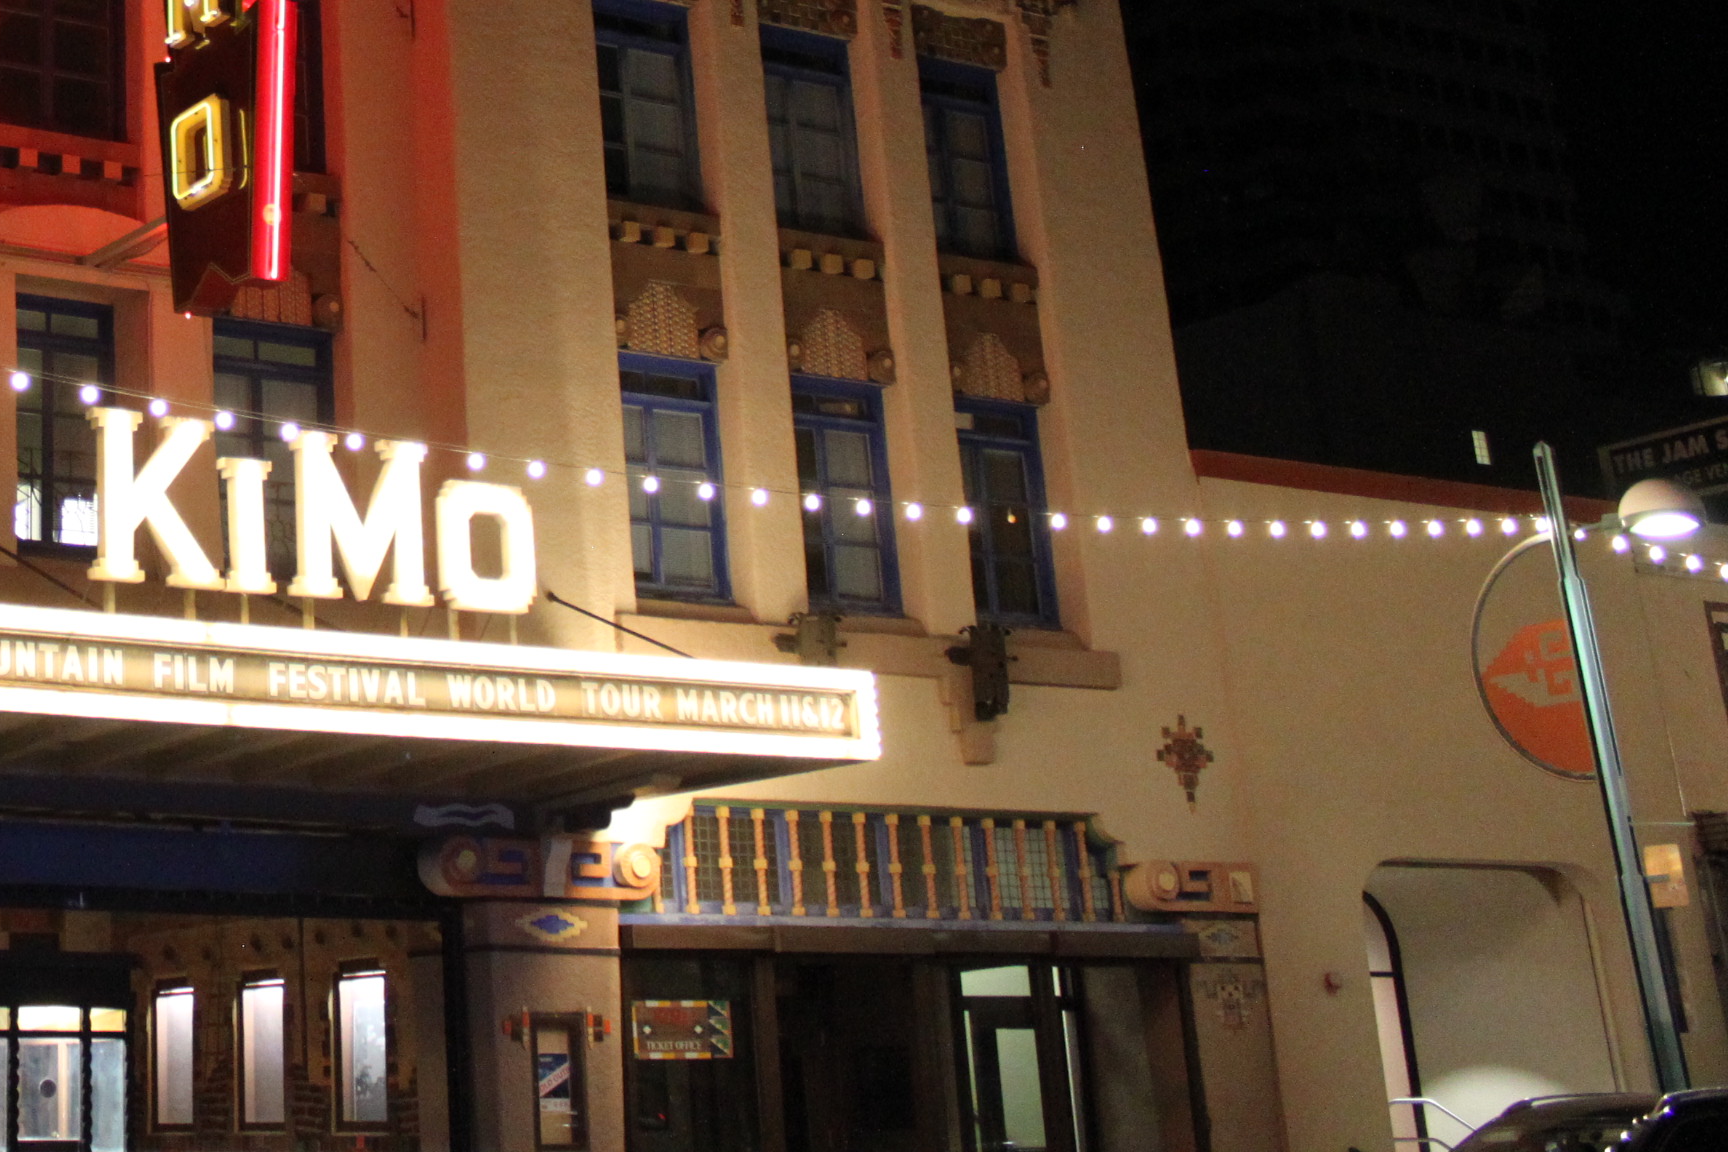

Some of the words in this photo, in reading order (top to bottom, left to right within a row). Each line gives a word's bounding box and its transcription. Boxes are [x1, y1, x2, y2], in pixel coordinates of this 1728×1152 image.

[1613, 448, 1655, 474] THE
[1662, 434, 1710, 464] JAM
[153, 653, 235, 694] FILM
[269, 662, 426, 706] FESTIVAL
[447, 673, 557, 712] WORLD
[581, 682, 663, 720] TOUR
[677, 688, 772, 725] MARCH
